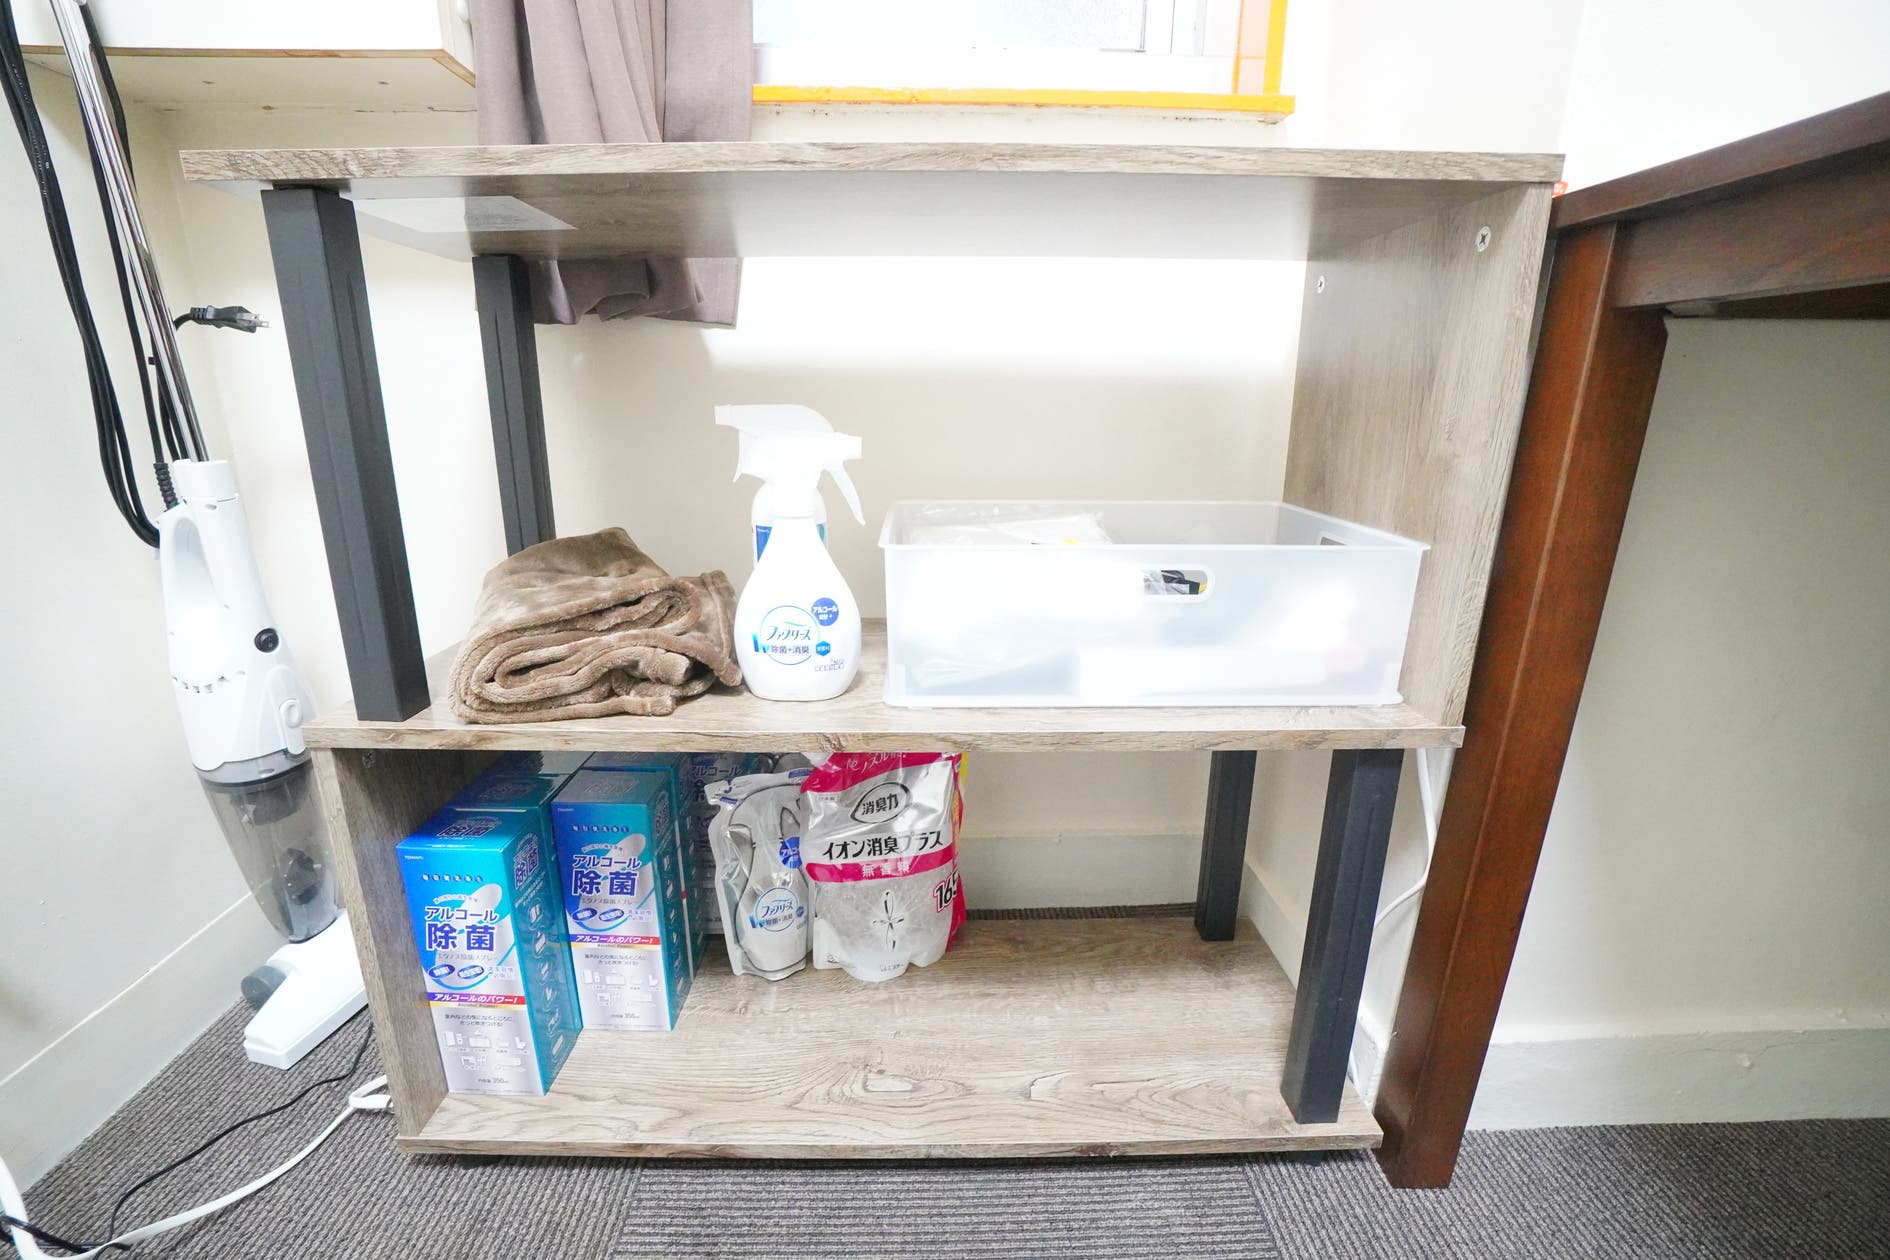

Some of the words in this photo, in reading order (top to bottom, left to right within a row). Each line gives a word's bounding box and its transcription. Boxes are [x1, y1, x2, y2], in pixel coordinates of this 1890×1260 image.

[862, 793, 899, 815] 消臭力
[823, 831, 943, 860] イオン消臭プラス
[573, 855, 640, 869] アルコール
[573, 870, 637, 896] 除菌
[425, 907, 497, 921] アルコール
[427, 923, 495, 951] 除菌
[434, 993, 517, 1004] アルコールのパワー!
